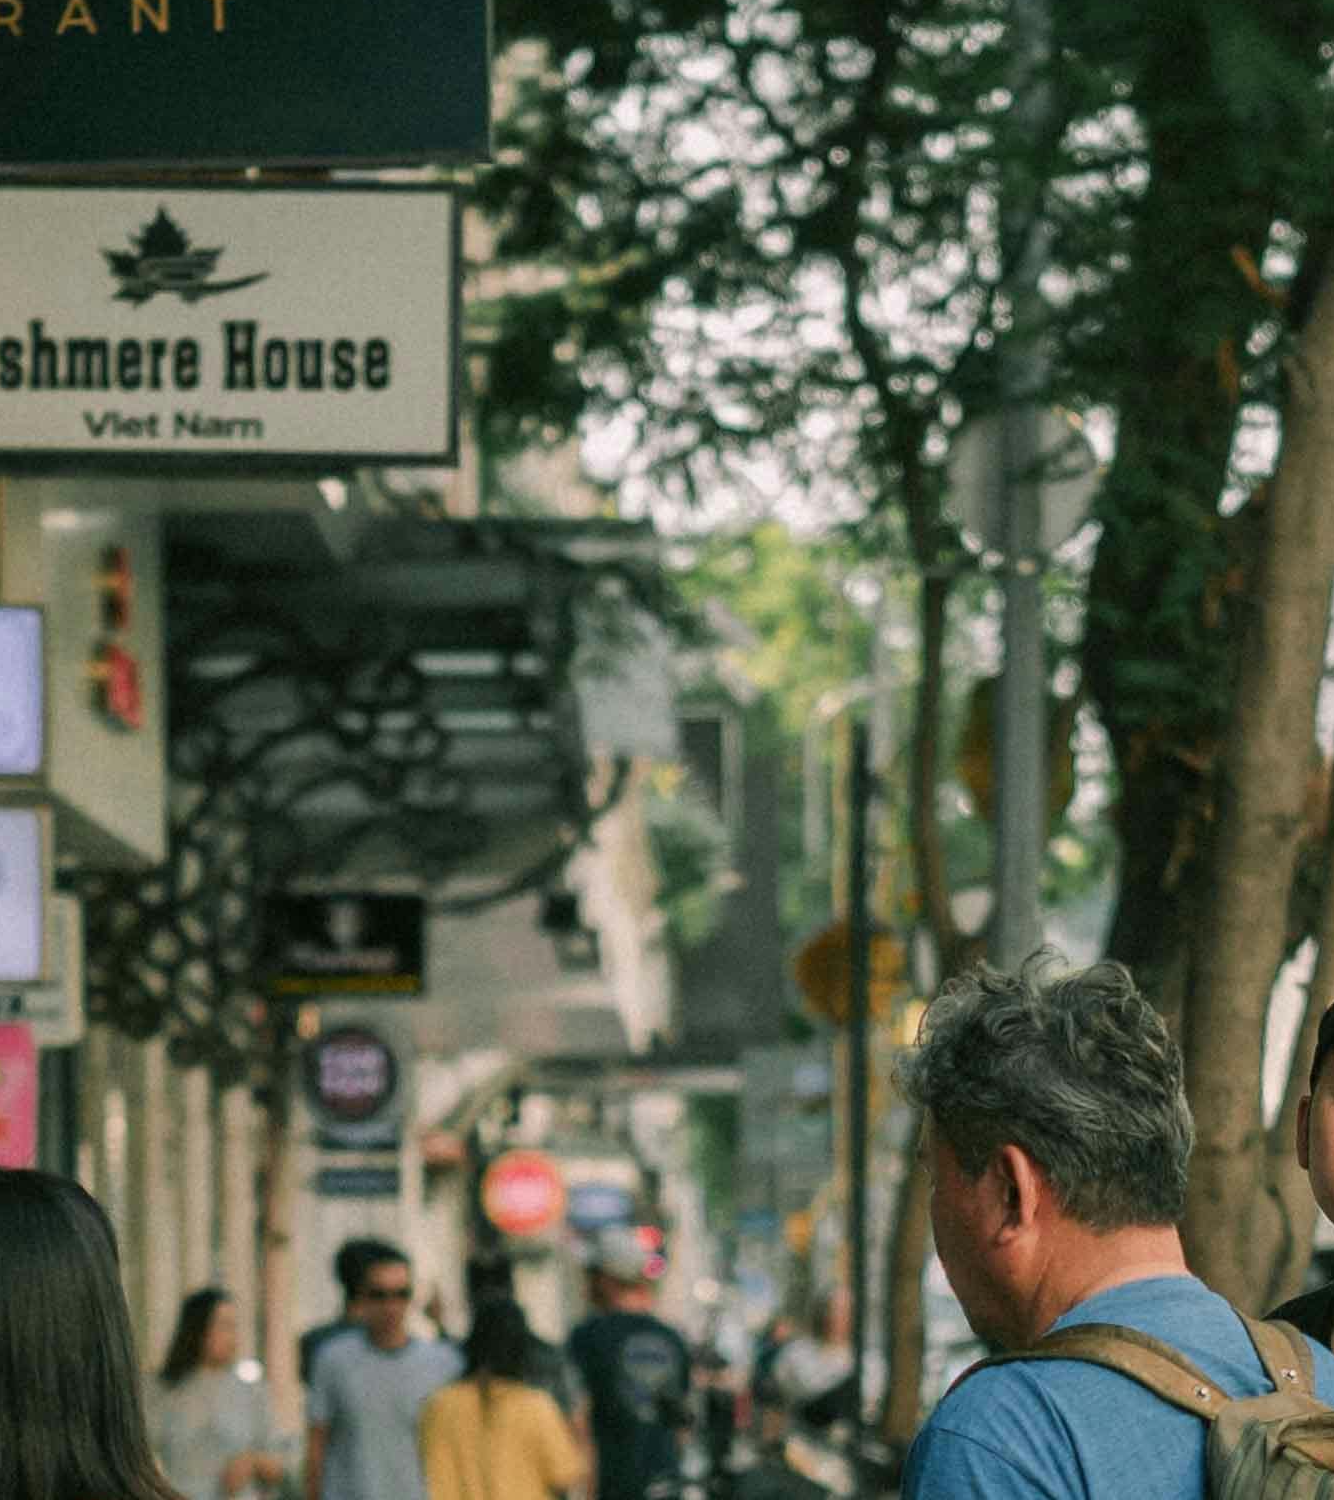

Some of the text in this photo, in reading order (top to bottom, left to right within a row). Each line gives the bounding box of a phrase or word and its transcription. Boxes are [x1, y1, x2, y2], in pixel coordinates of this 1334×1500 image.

[222, 320, 392, 392] House
[82, 411, 265, 440] Viet Nam
